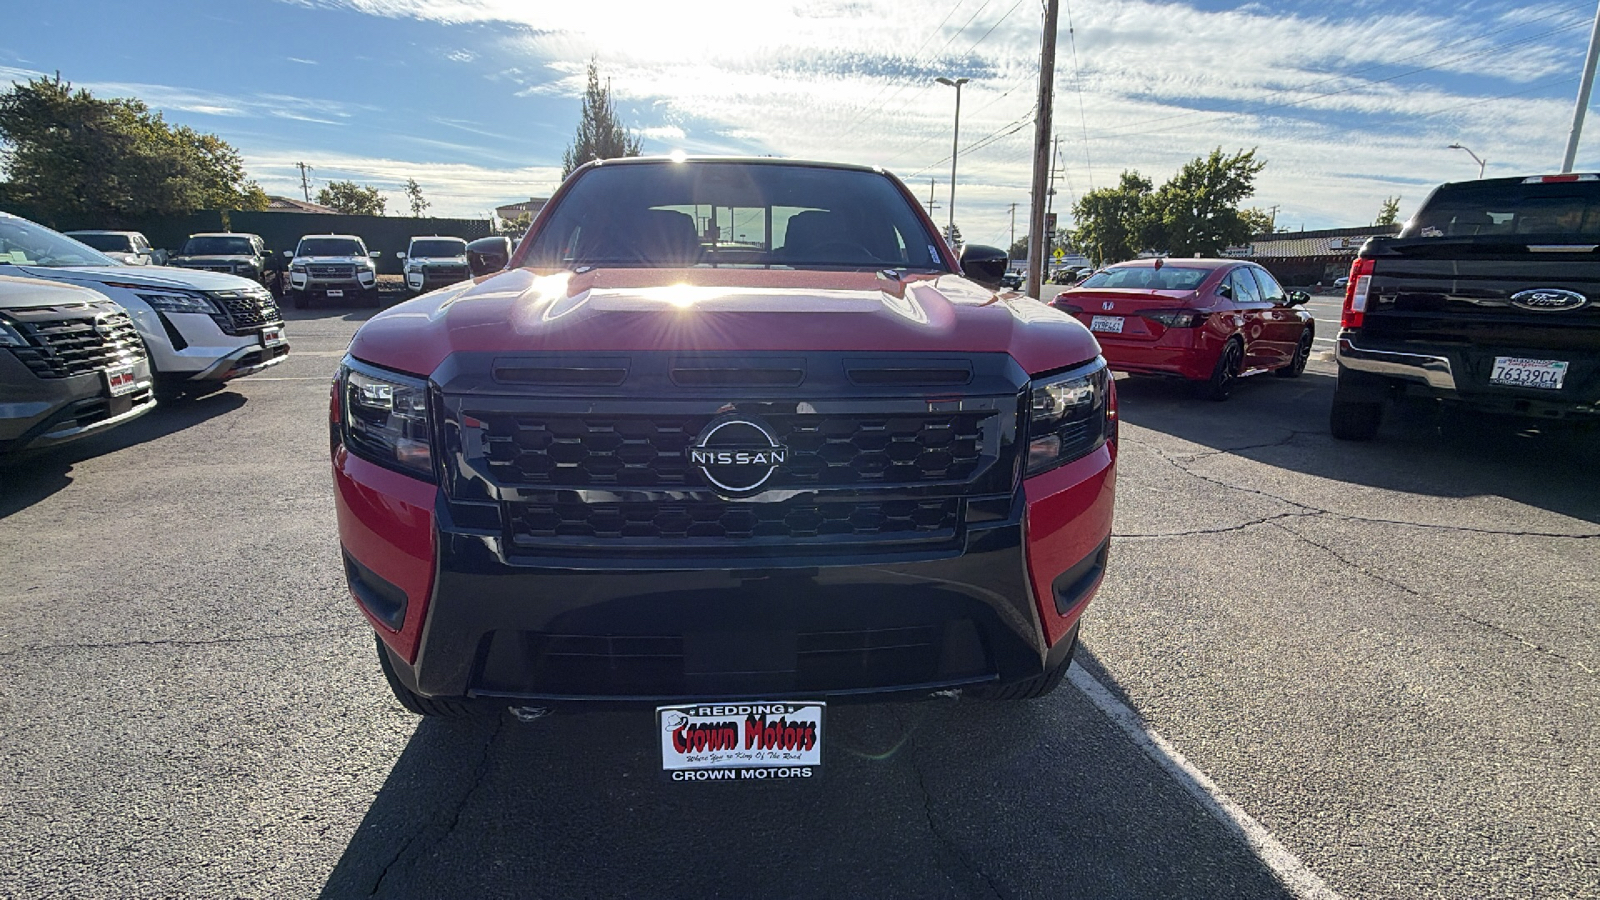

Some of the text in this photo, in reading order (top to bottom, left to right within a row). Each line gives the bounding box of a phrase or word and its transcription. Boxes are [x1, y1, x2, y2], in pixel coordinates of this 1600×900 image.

[1527, 292, 1568, 306] Ford
[1497, 366, 1558, 384] 76339C4
[691, 451, 784, 464] NISSAN
[698, 705, 785, 716] REDDING
[672, 714, 817, 754] Crown Motors
[735, 752, 752, 760] King
[755, 752, 765, 760] Of
[767, 752, 780, 760] The
[672, 767, 813, 781] CROWN MOTORS
